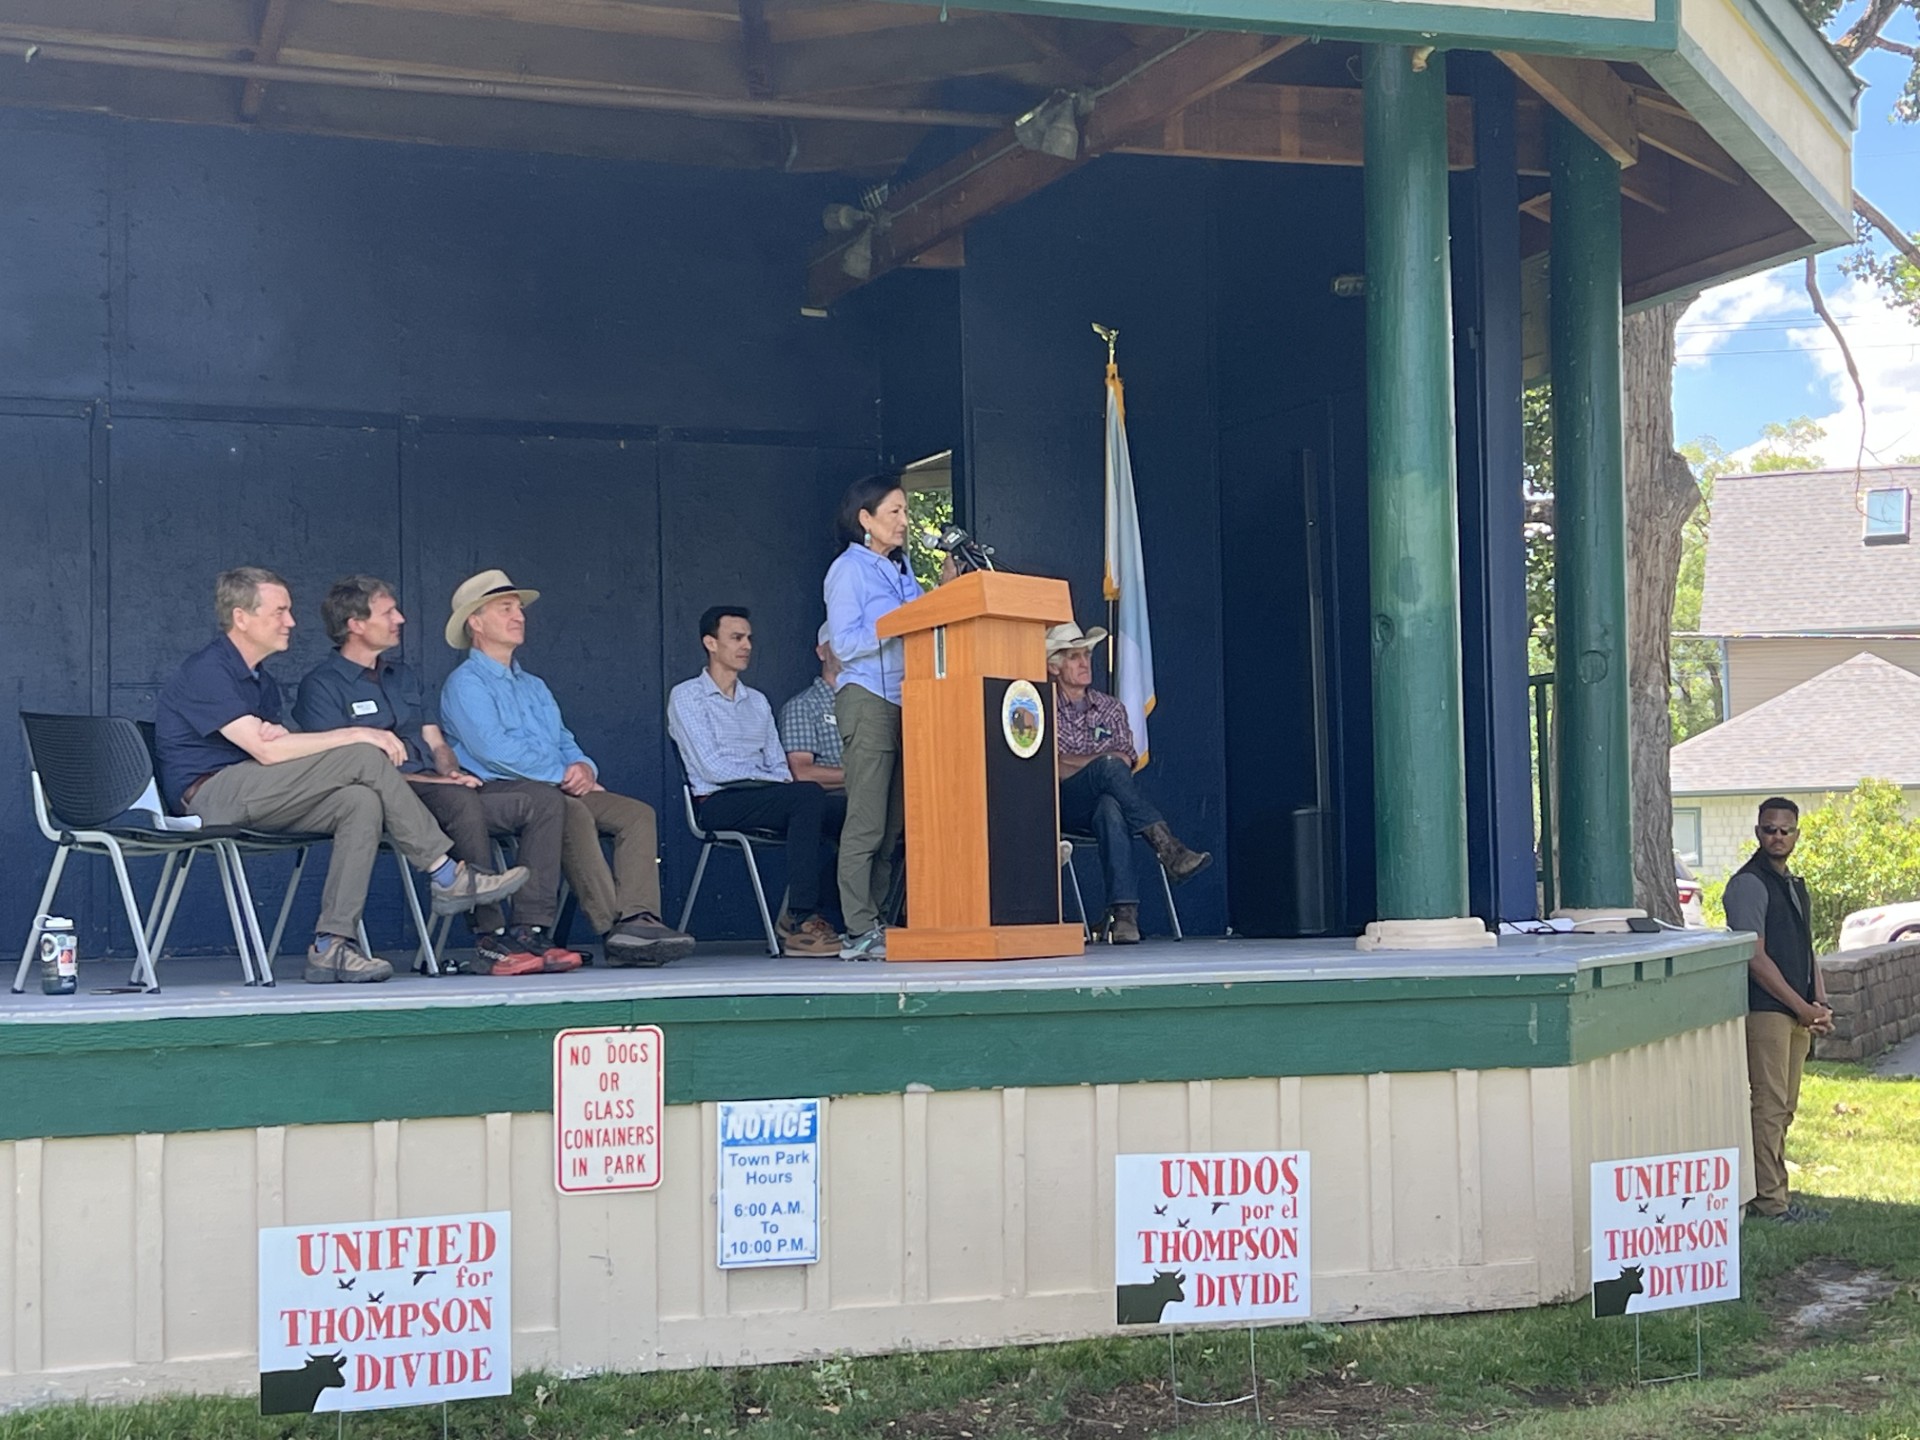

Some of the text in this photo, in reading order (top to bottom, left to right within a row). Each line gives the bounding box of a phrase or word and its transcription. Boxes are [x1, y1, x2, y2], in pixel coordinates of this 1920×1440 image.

[570, 1043, 649, 1066] NO DOGS
[599, 1072, 620, 1092] OR
[584, 1099, 635, 1121] GLASS
[564, 1125, 655, 1150] CONTAINERS
[726, 1110, 814, 1140] NOTICE
[572, 1153, 646, 1177] IN PARK
[729, 1150, 810, 1167] Town Park
[746, 1171, 793, 1185] Hours
[1160, 1154, 1299, 1198] UNIDOS
[1614, 1156, 1730, 1202] UNIFIED
[734, 1200, 805, 1217] 6:00 A.M.
[1241, 1196, 1298, 1226] por el
[1706, 1193, 1729, 1211] for
[761, 1220, 779, 1234] To
[1604, 1218, 1728, 1261] THOMPSON
[297, 1221, 497, 1276] UNIFIED
[730, 1237, 808, 1255] 10:00 P.M.
[1137, 1226, 1298, 1264] THOMPSON
[456, 1265, 493, 1288] for
[1648, 1259, 1729, 1298] DIVIDE
[1194, 1272, 1299, 1308] DIVIDE
[280, 1296, 493, 1347] THOMPSON
[353, 1347, 493, 1393] DIVIDE
